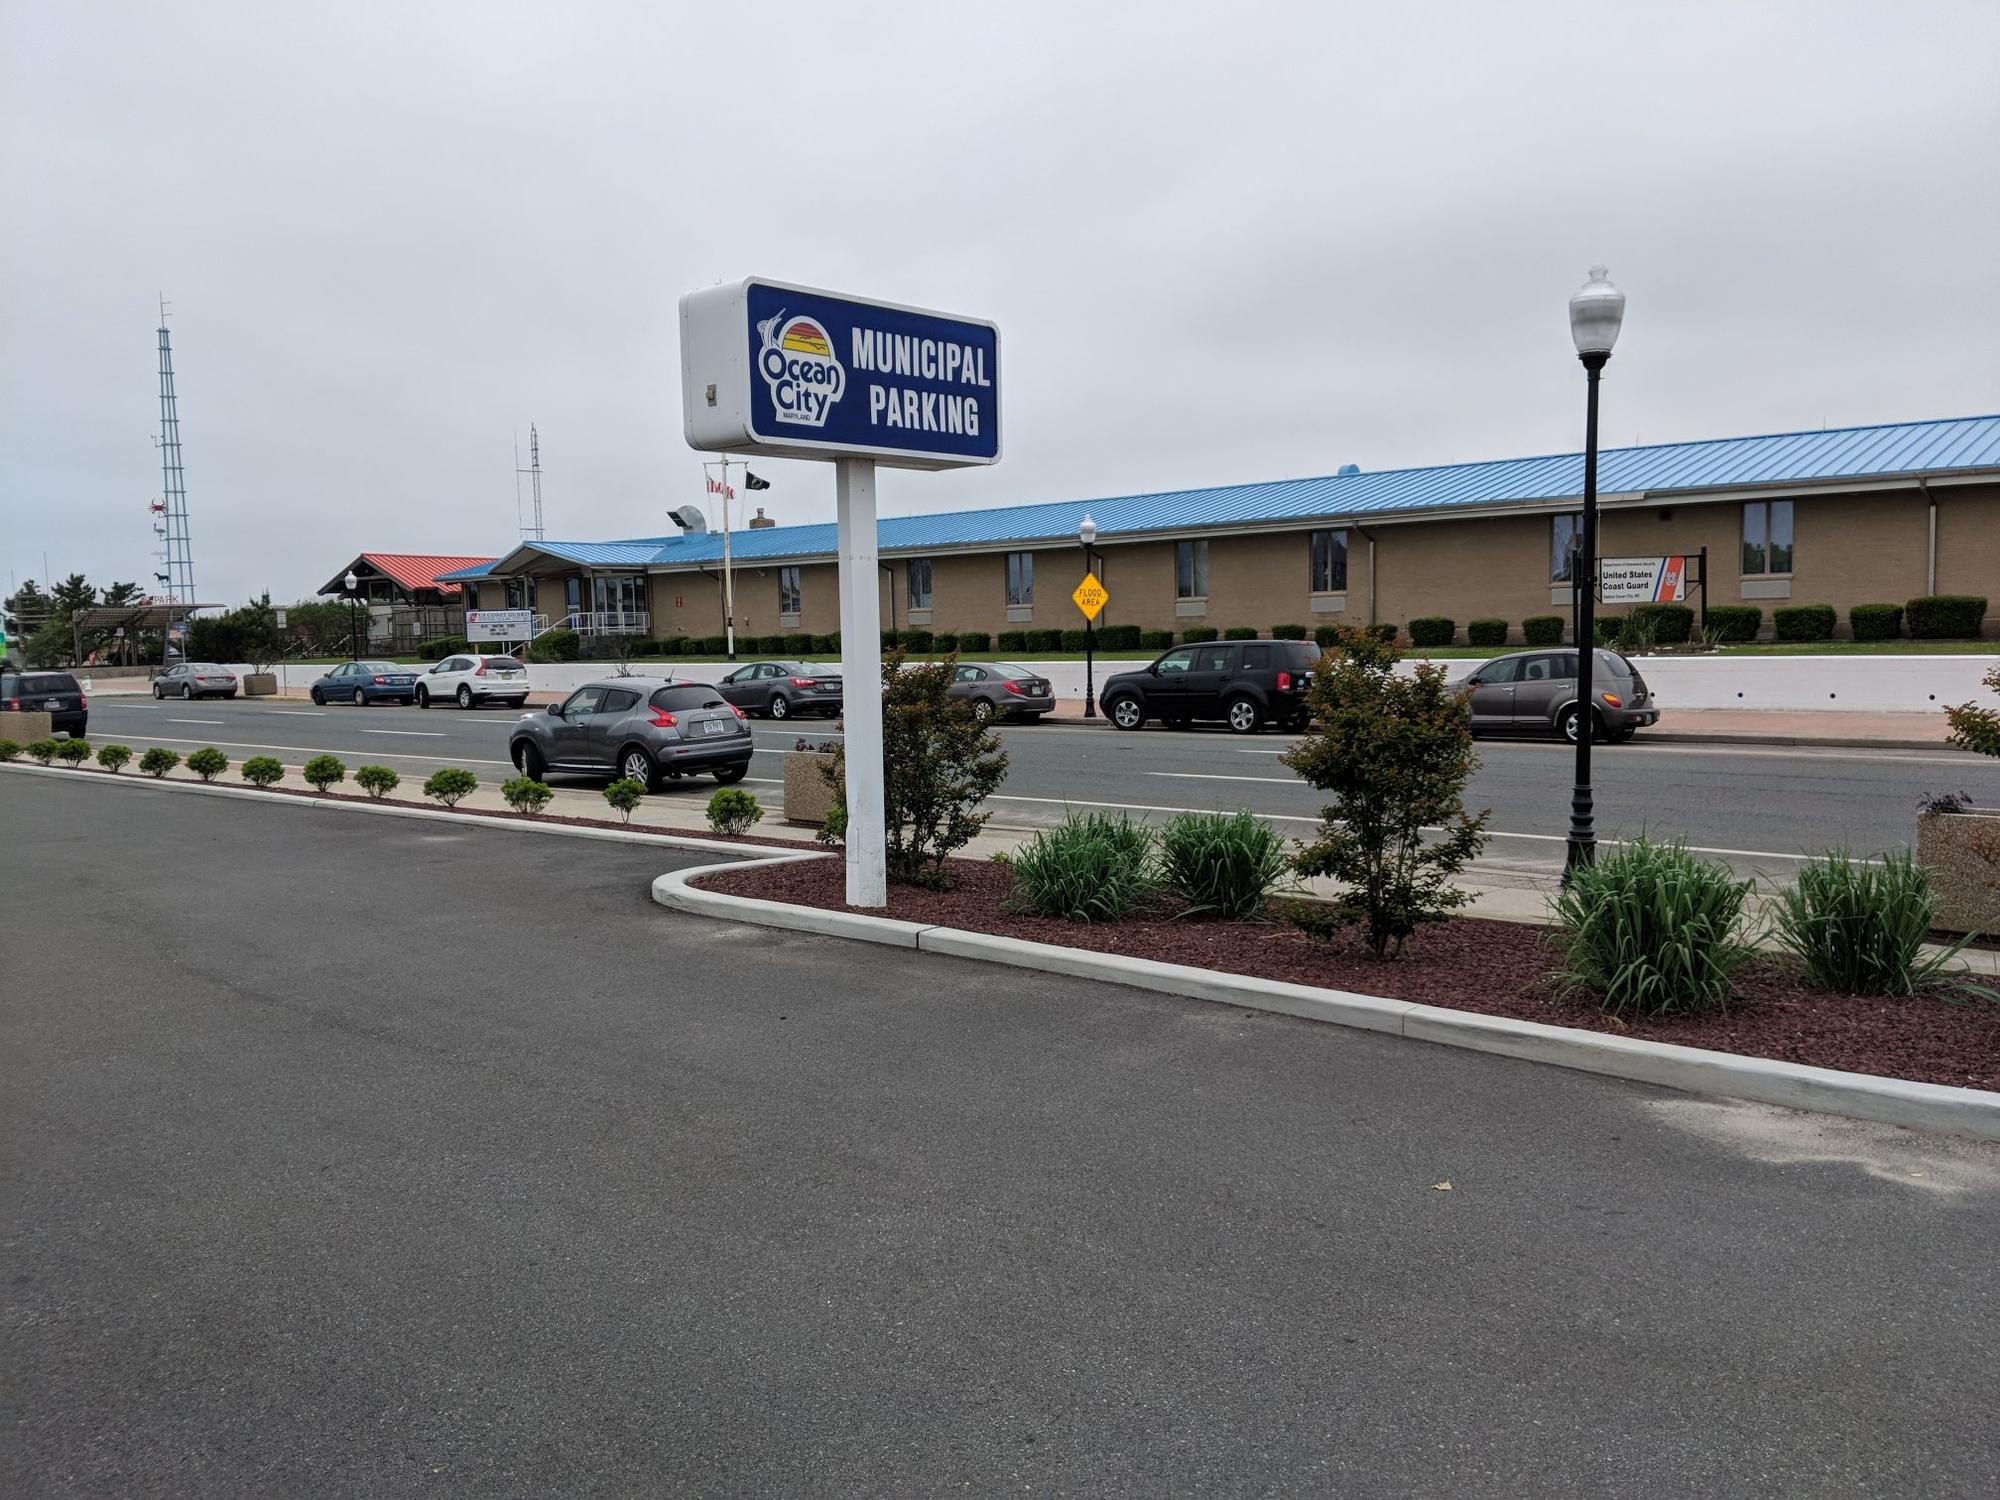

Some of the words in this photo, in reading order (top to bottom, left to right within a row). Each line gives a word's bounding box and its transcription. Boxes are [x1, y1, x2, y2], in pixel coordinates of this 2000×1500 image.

[852, 327, 991, 387] MUNICIPAL
[763, 348, 841, 394] Ocean
[776, 380, 828, 421] City
[870, 384, 979, 436] PARKING
[783, 412, 811, 421] MARYLAND
[1603, 571, 1627, 579] United
[1629, 570, 1653, 578] States
[1602, 582, 1624, 590] Coast
[1626, 581, 1649, 589] Guard
[1080, 588, 1102, 597] FLOOD
[154, 595, 180, 604] PARK
